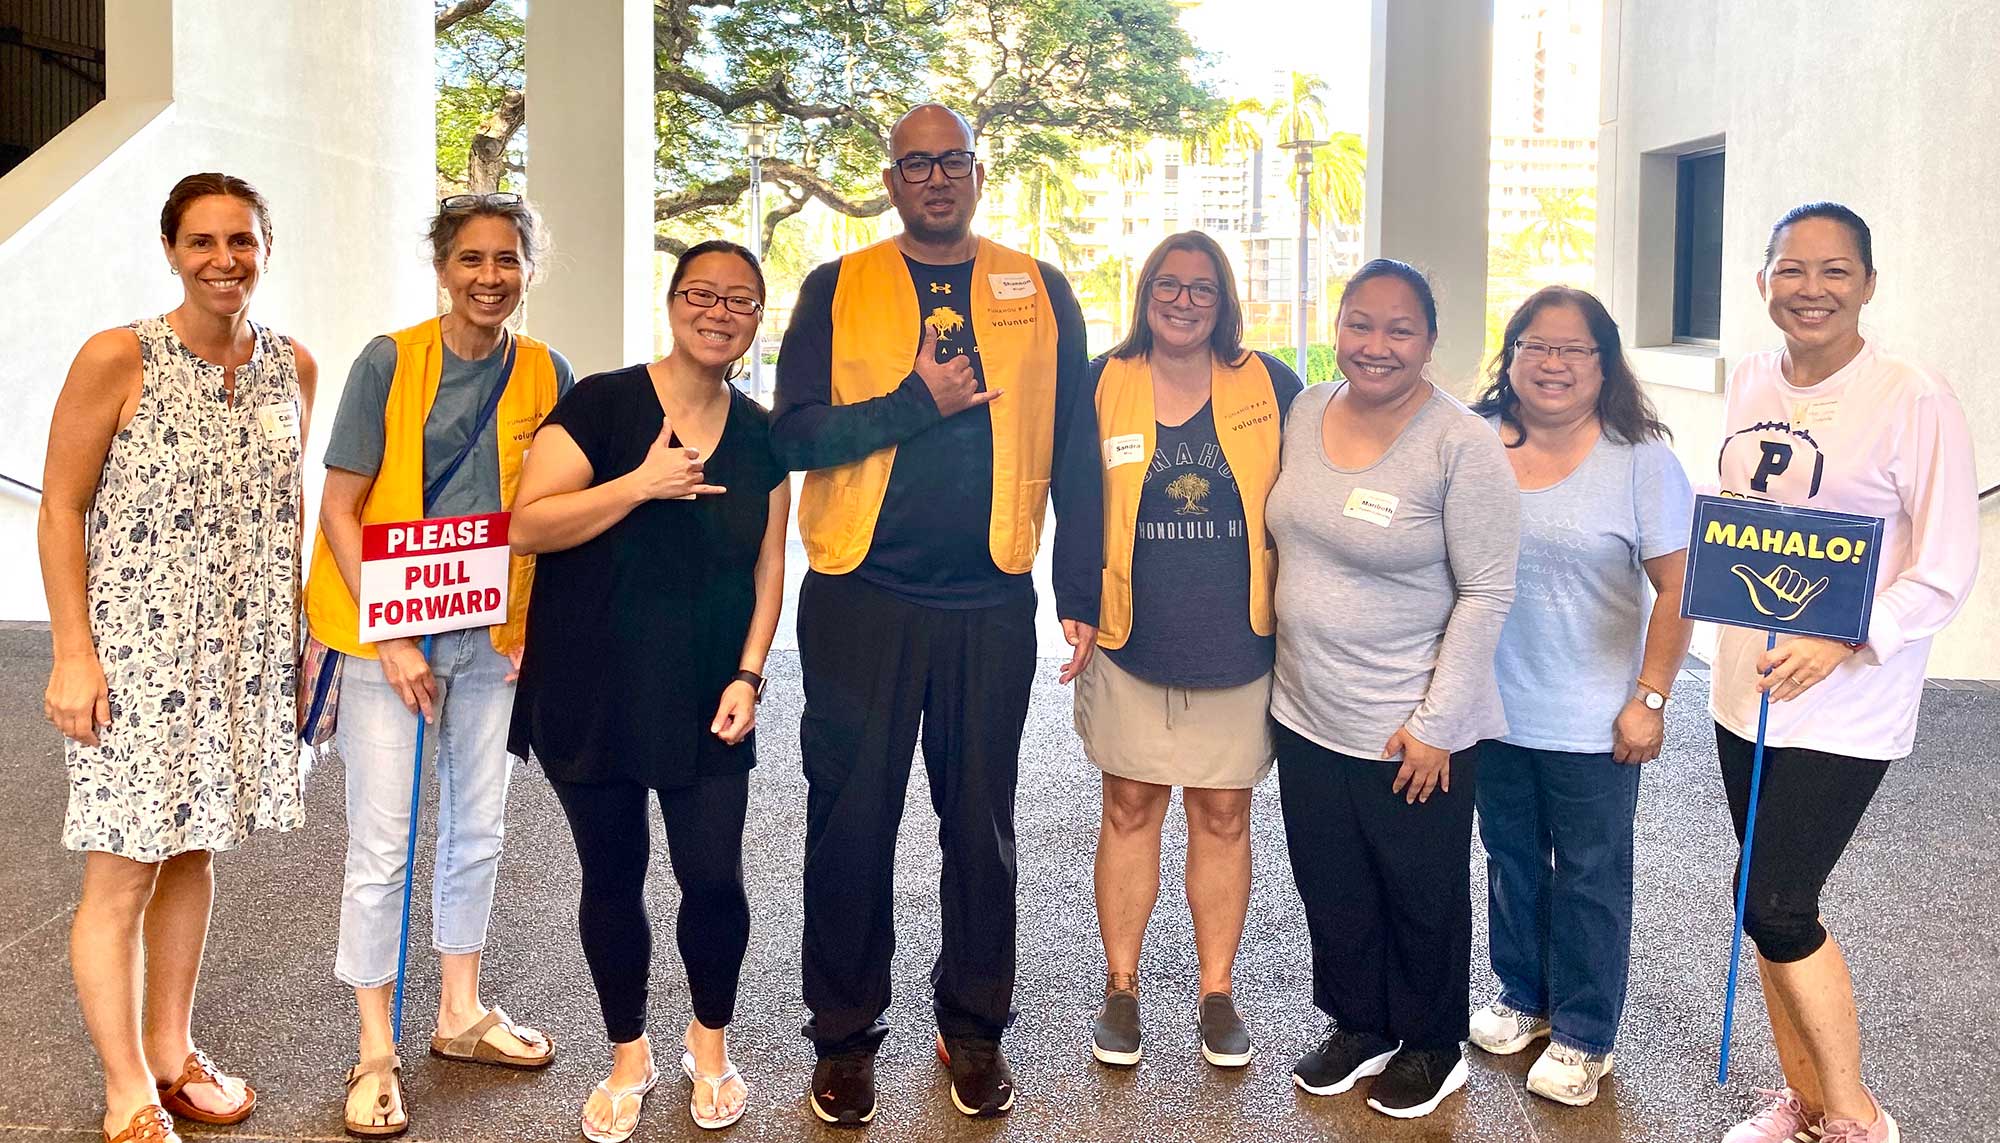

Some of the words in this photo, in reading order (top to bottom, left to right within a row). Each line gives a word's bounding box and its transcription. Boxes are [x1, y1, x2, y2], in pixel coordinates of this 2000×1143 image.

[1231, 413, 1273, 432] voluneer
[1750, 440, 1793, 493] P
[387, 519, 489, 553] PLEASE
[1228, 519, 1242, 537] HI
[1704, 520, 1867, 564] MAHALO!
[405, 560, 470, 591] PULL
[368, 587, 501, 628] FORWARD
